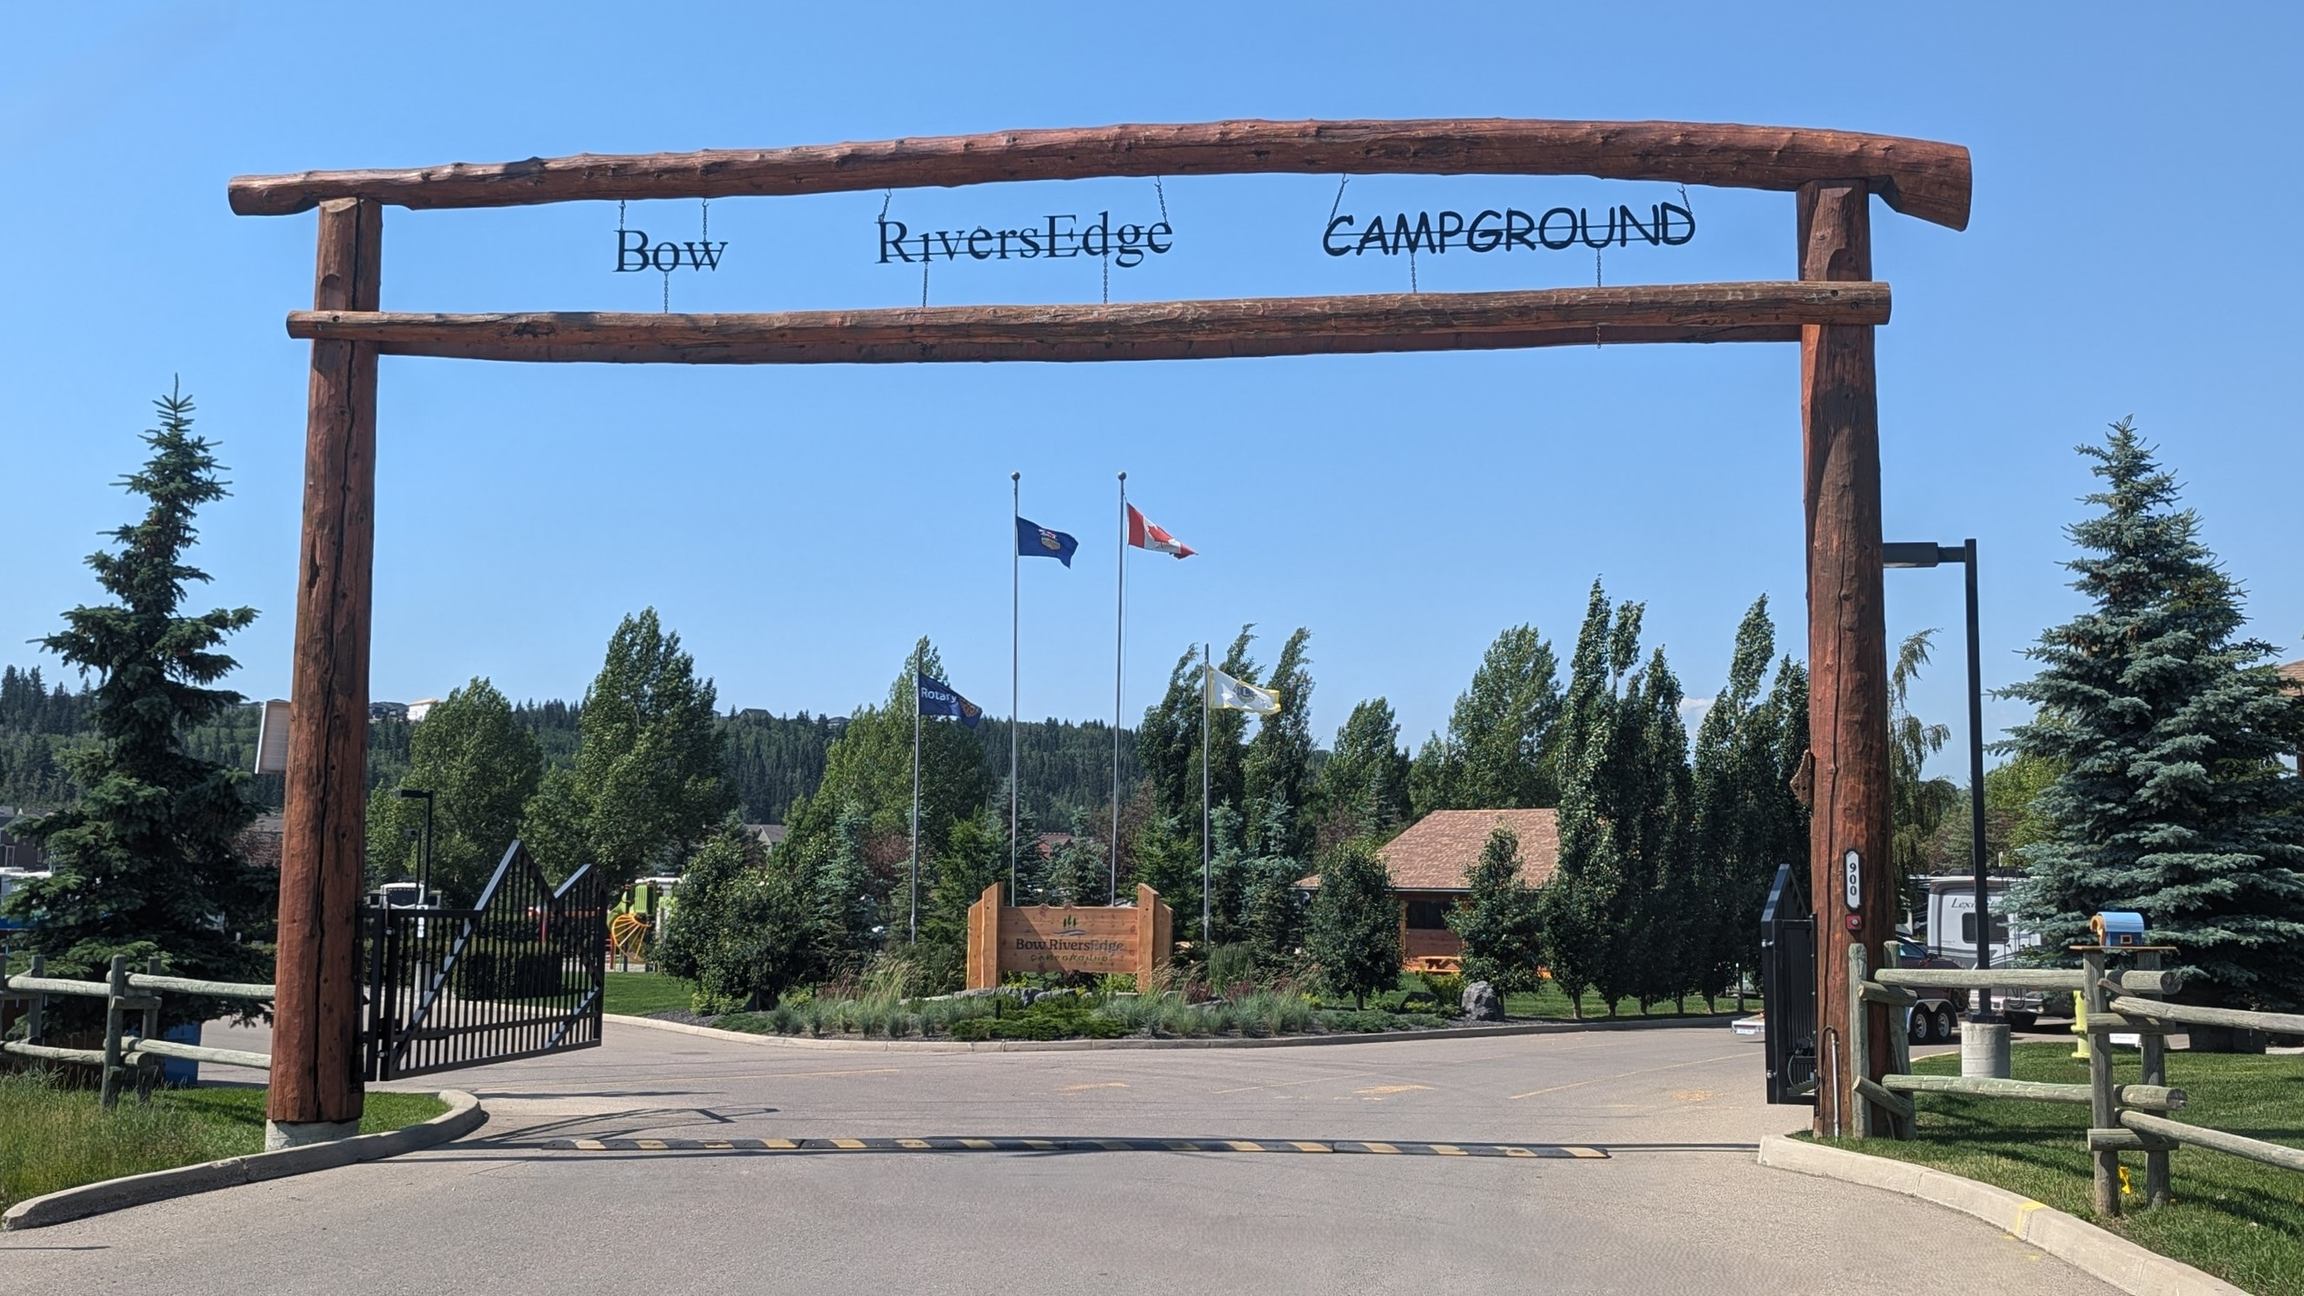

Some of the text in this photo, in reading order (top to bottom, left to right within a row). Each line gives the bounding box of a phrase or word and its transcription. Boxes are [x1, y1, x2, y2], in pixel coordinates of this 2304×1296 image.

[613, 201, 1696, 273] Bow RiversEdge CAMPGROUND
[920, 687, 957, 703] Rotary
[1849, 862, 1857, 896] 900
[1016, 938, 1124, 953] Bow RiversEdge
